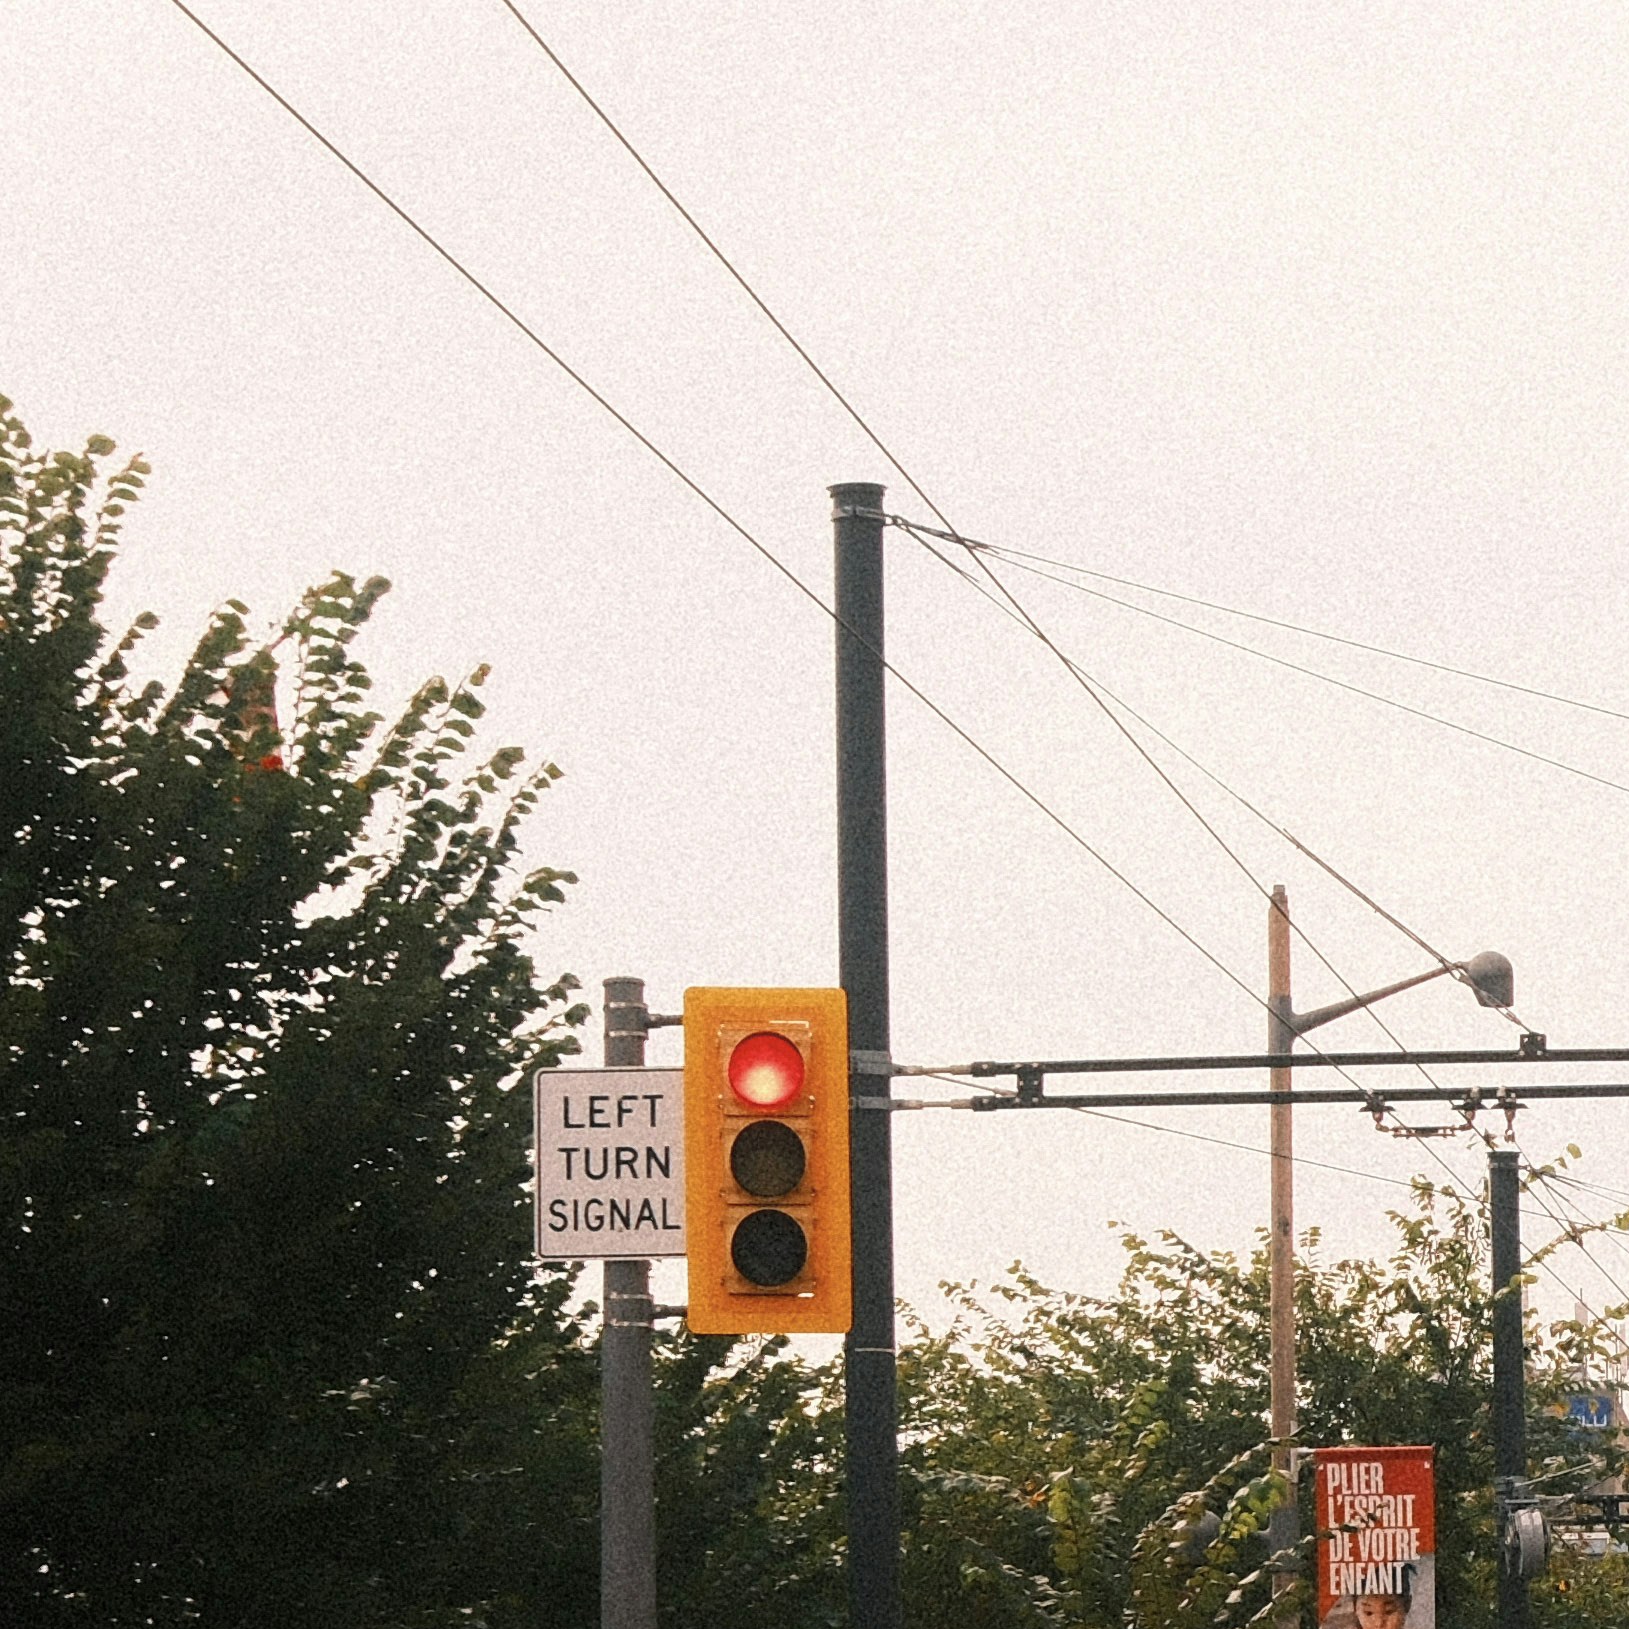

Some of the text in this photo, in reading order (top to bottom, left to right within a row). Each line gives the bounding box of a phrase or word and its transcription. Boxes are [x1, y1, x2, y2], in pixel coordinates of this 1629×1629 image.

[563, 1095, 664, 1129] LEFT
[557, 1146, 680, 1180] TURN
[549, 1198, 682, 1232] SIGNAL
[1327, 1462, 1384, 1495] PLIER
[1328, 1494, 1415, 1528] L'ESPRIT
[1329, 1527, 1421, 1562] DE VOTRE
[1329, 1562, 1406, 1596] ENFANT
